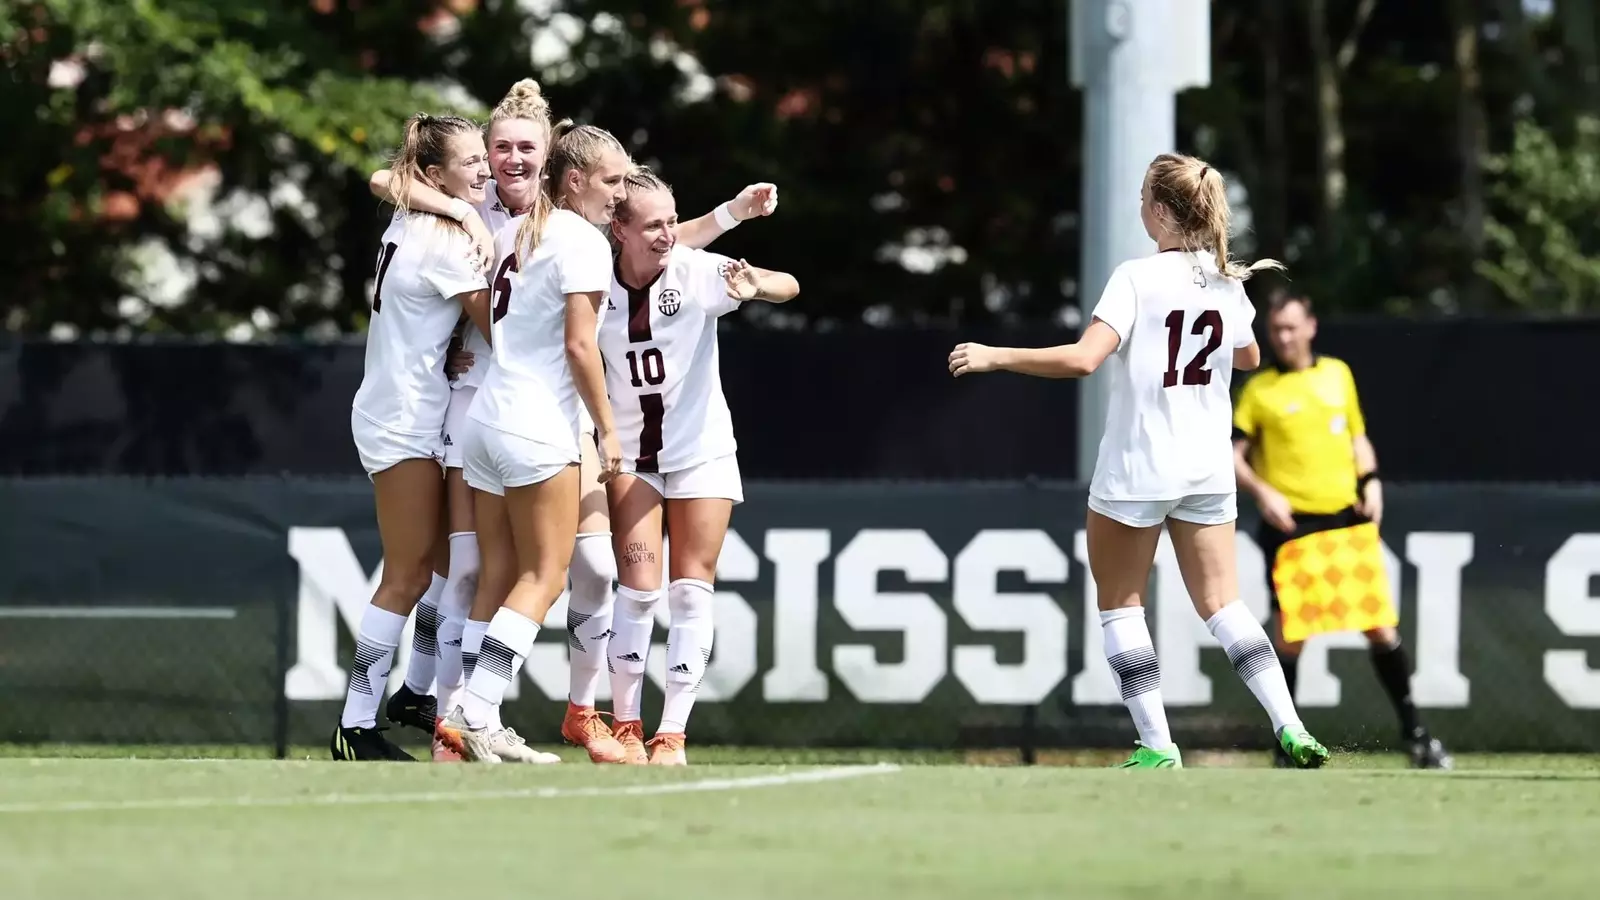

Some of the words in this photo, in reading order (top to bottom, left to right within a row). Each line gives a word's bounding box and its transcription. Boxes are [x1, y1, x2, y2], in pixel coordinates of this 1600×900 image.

[492, 252, 519, 325] 6
[625, 347, 666, 388] 10
[1163, 309, 1223, 388] 12
[625, 541, 648, 554] TRUST
[284, 526, 1474, 707] MSISSPI
